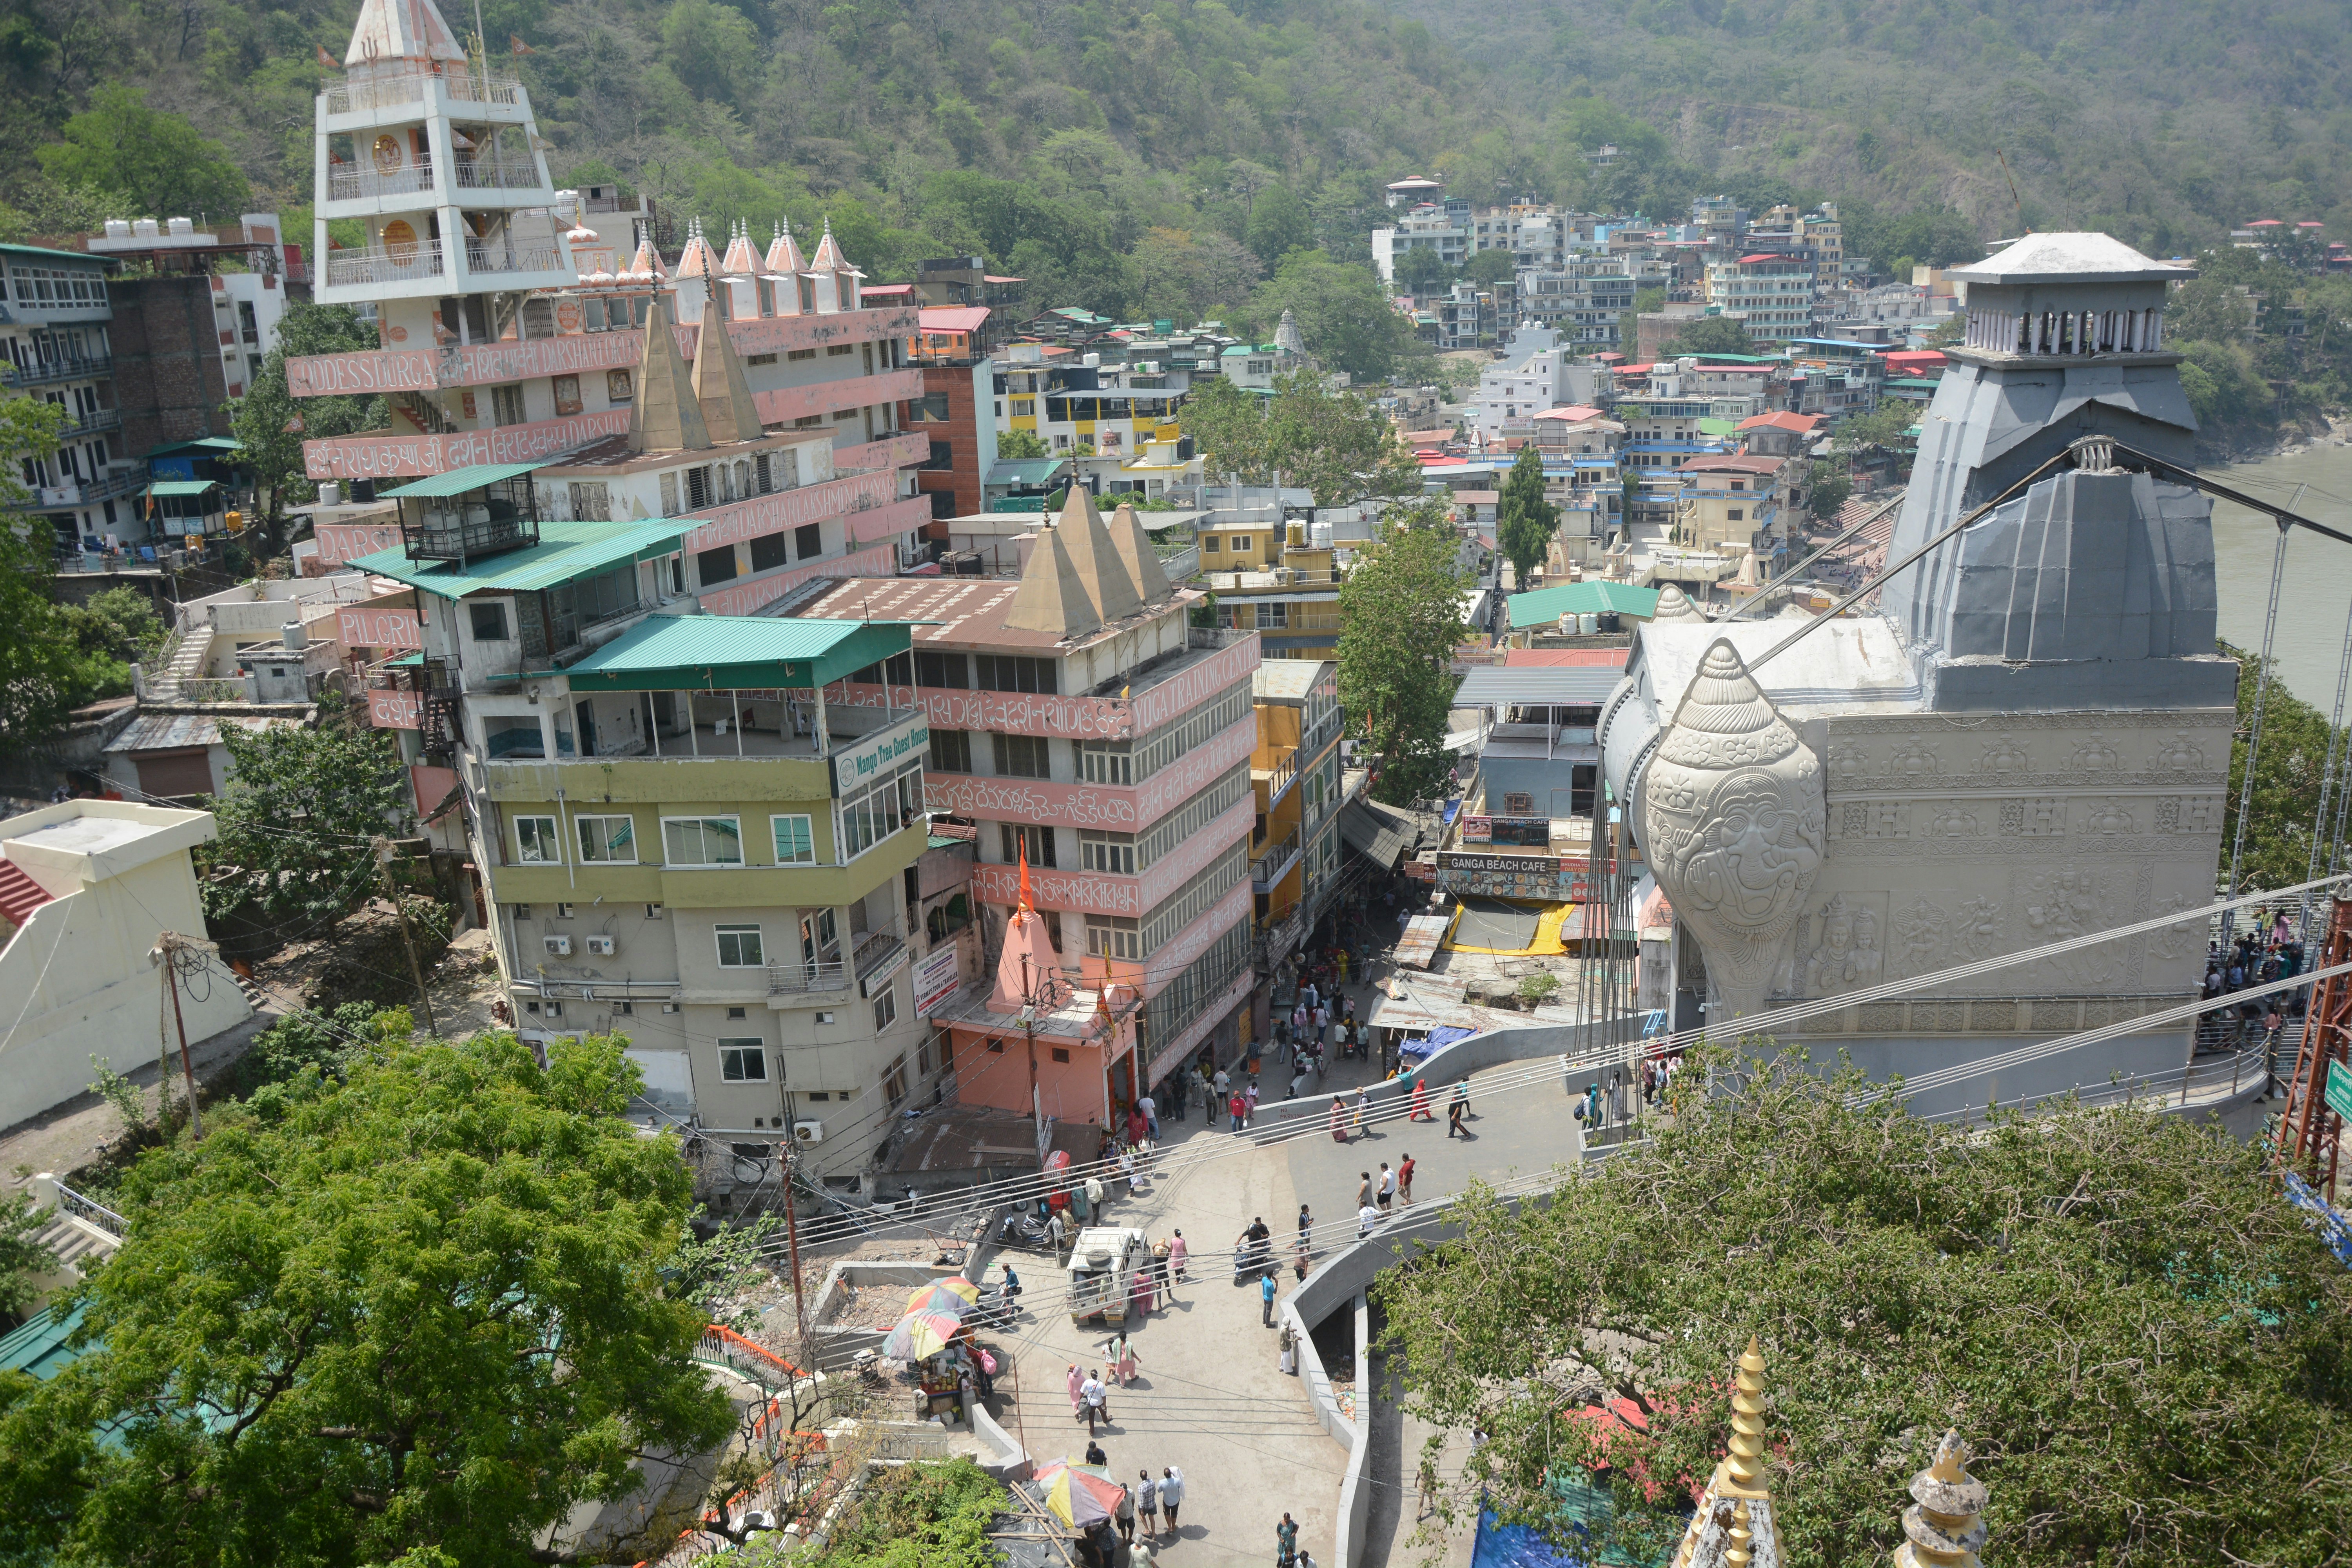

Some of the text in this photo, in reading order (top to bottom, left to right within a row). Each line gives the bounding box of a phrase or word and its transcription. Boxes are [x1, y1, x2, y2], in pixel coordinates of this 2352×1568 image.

[290, 354, 438, 390] GODDESS DURGA
[541, 338, 598, 372] DARSHAN
[599, 334, 632, 365] LORD
[307, 441, 347, 475] दर्शन
[347, 445, 381, 475] राधा
[420, 437, 445, 472] जी
[448, 432, 491, 468] दर्शन
[491, 428, 529, 461] विराट
[740, 492, 797, 537] DARSHAN
[797, 483, 846, 523] LAKSHMI
[845, 474, 897, 510] NARAYAN
[1132, 635, 1260, 733] YOGA TRAINING CENTRE
[856, 726, 928, 776] Mango Tree Guest House
[1139, 783, 1163, 821] दर्शन
[1165, 765, 1184, 802] बद्री
[1186, 759, 1209, 789] केदार
[1209, 732, 1232, 773] गंगोत्री
[1451, 858, 1546, 872] GANGA BEACH CAFE
[1210, 902, 1230, 935] मिशन
[1231, 887, 1248, 920] ट्रस्ट
[873, 969, 884, 982] Mango
[891, 954, 899, 966] Guest
[899, 947, 908, 959] House
[918, 960, 930, 971] Mango
[937, 949, 946, 959] Guest
[946, 944, 956, 954] House
[942, 960, 953, 969] AVAILABLE
[920, 987, 933, 1000] VERMA'S
[943, 971, 958, 985] TRAVELLER
